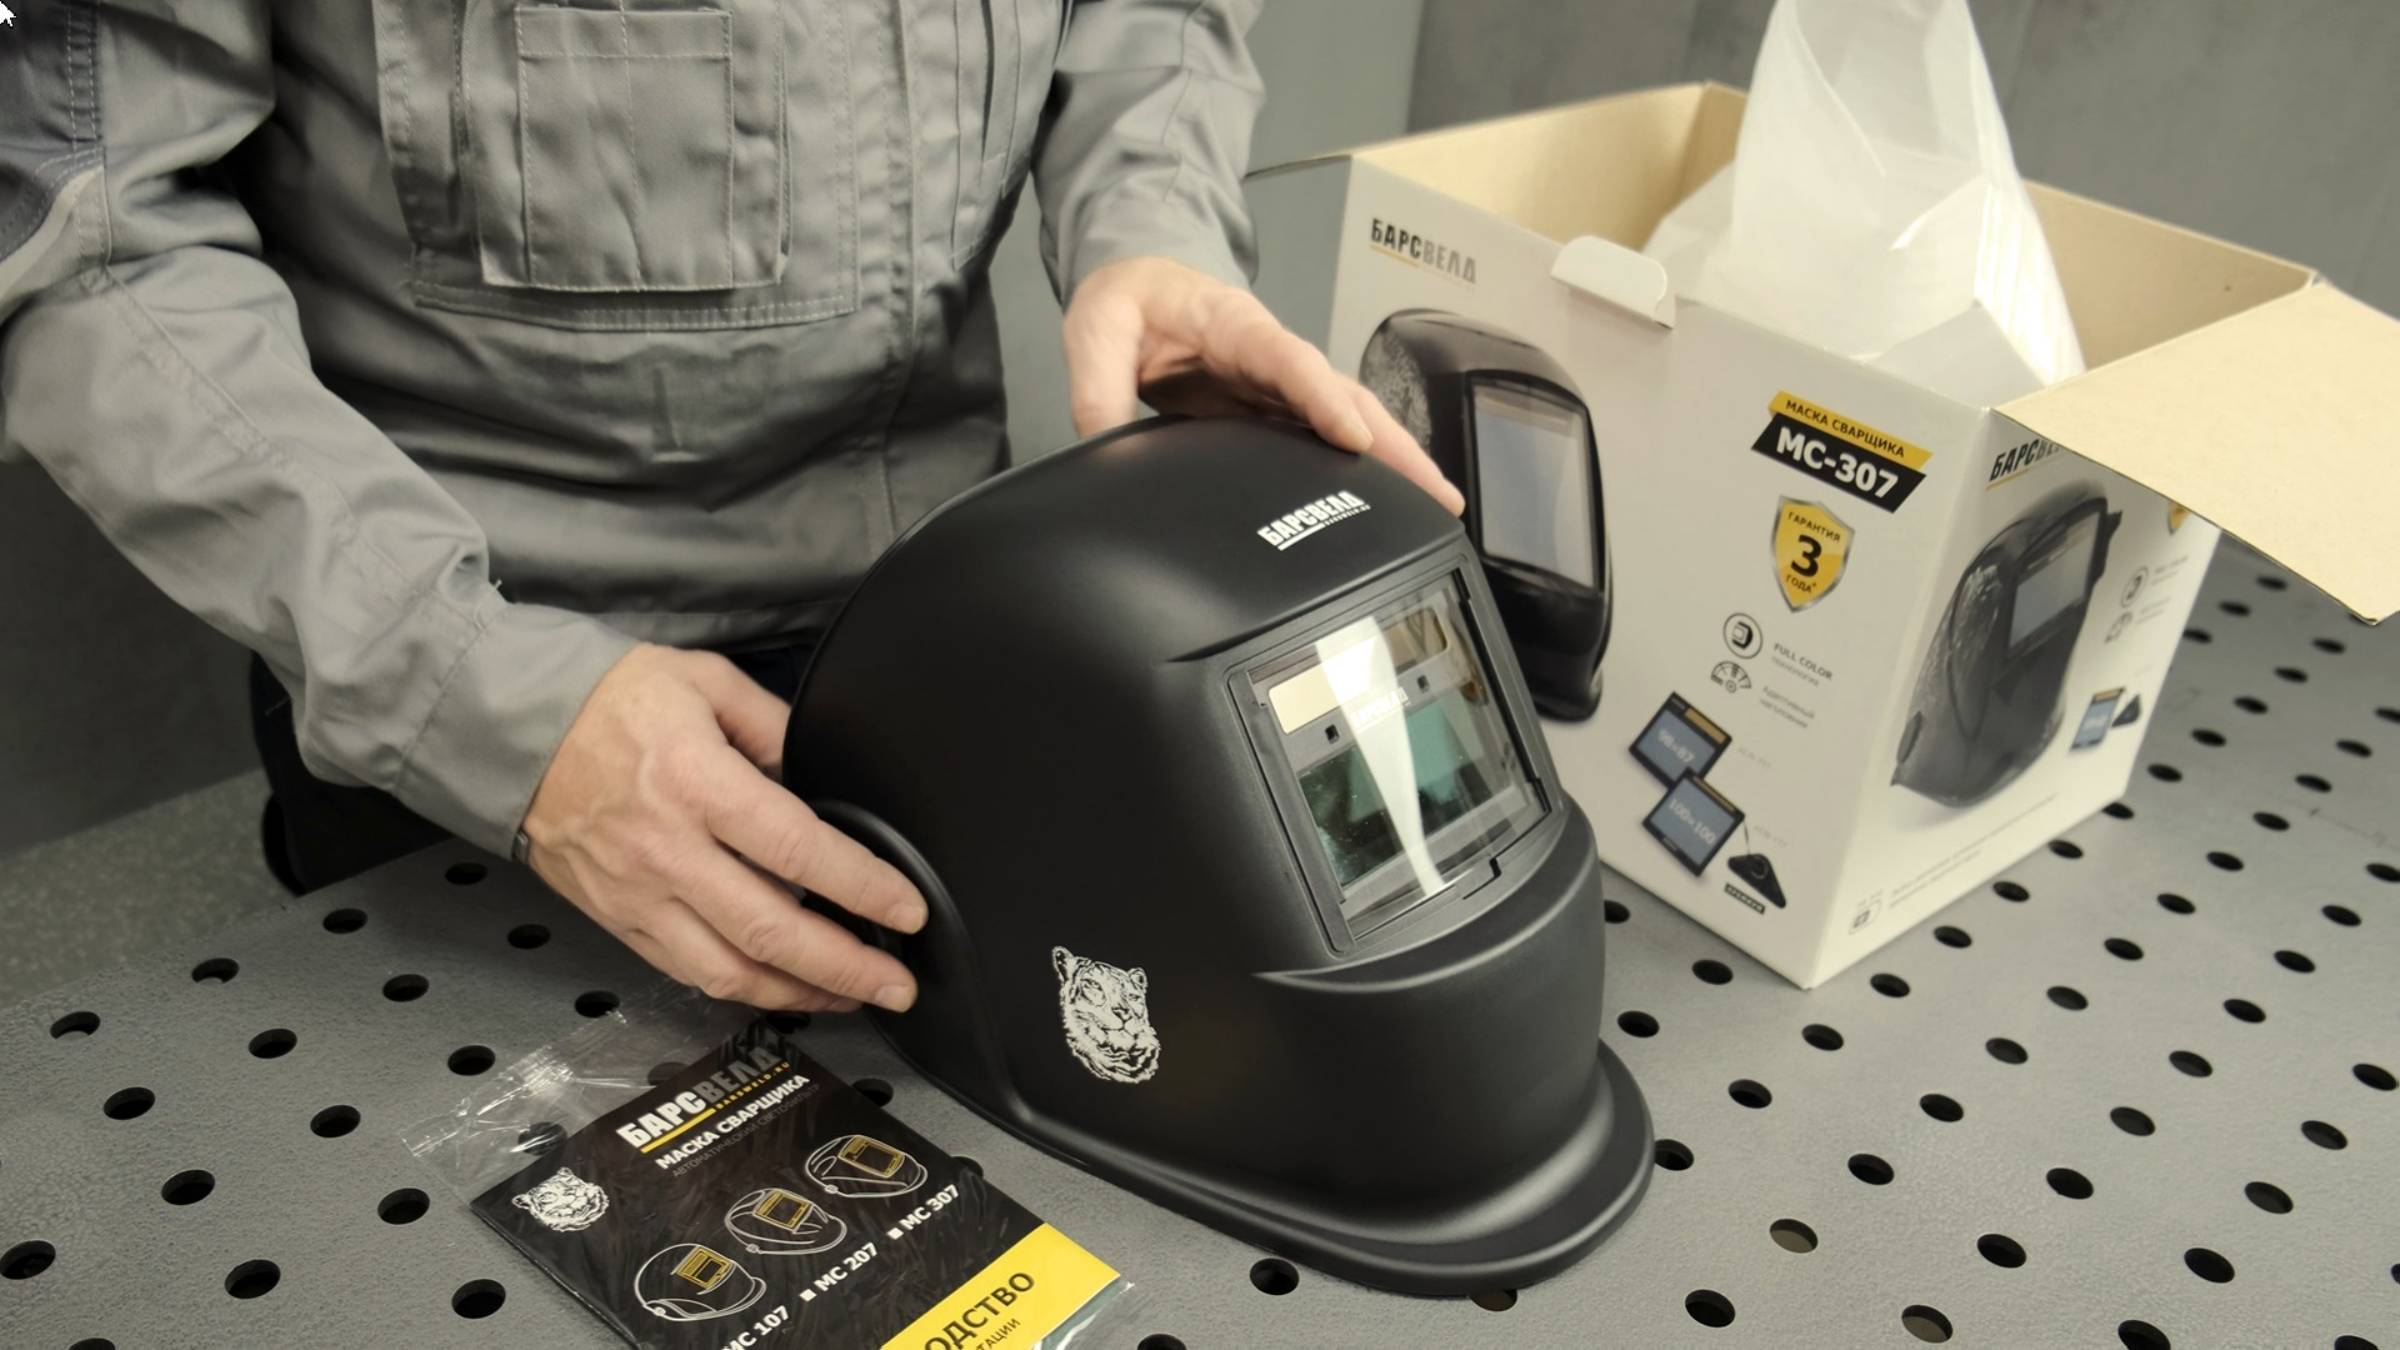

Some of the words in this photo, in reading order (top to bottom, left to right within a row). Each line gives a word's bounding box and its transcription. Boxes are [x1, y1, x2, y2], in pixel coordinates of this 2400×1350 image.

[1371, 218, 1476, 284] БАРСВЕЛД
[1786, 400, 1829, 426] МАСКА
[1832, 418, 1905, 458] СВАРЩИКА
[1776, 426, 1899, 499] МС-307
[1256, 490, 1366, 547] БАРСВЕЛД
[1787, 510, 1841, 543] ГАРАНТИЯ
[1790, 533, 1823, 578] 3
[1773, 642, 1797, 662] FULL
[1799, 656, 1833, 681] COLOR
[615, 1046, 783, 1149] БАРСВЕЛД
[655, 1130, 720, 1170] МАСКА
[716, 1074, 811, 1134] СВАРЩИКА
[899, 1206, 932, 1231] МС
[926, 1184, 960, 1213] 307
[813, 1266, 848, 1292] МС
[843, 1242, 879, 1271] 207
[754, 1305, 790, 1336] 107
